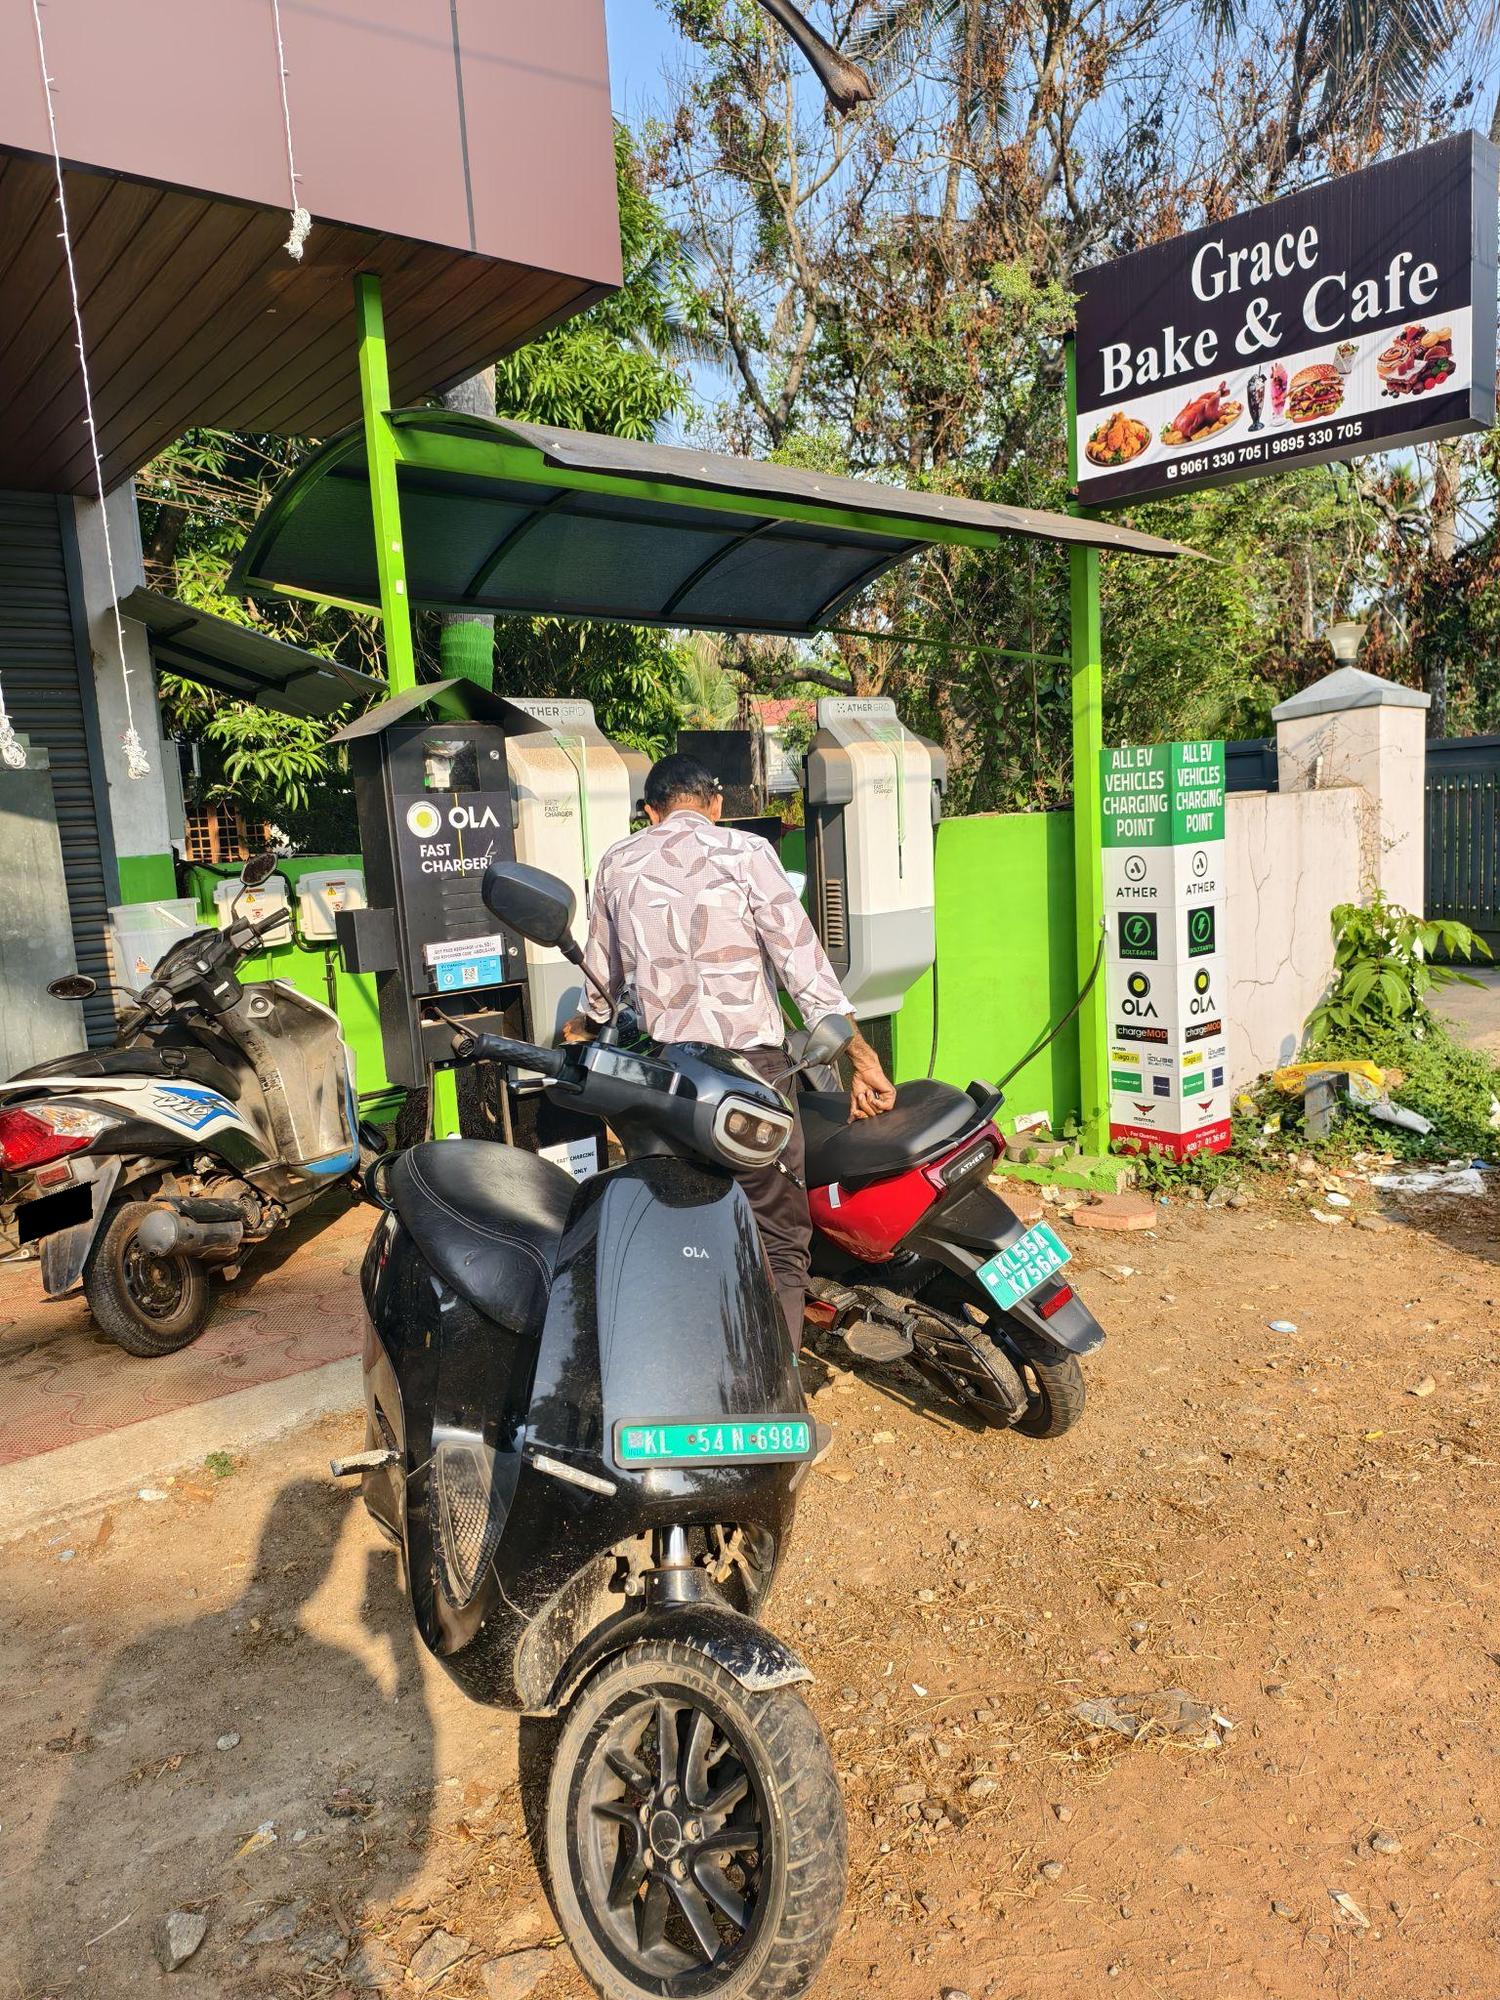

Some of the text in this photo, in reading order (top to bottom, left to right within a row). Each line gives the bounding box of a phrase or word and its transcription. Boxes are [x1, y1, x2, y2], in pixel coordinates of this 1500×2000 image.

[1191, 225, 1318, 301] Grace
[1099, 251, 1438, 397] Bake & Cafe
[1180, 458, 1208, 475] 9061
[1212, 452, 1235, 469] 330
[1238, 445, 1262, 462] 705
[1272, 435, 1304, 454] 9895
[1308, 428, 1333, 446] 330
[1337, 421, 1362, 440] 705
[1112, 748, 1153, 769] ALL EV
[1183, 743, 1212, 763] ALL EV
[1105, 770, 1164, 792] VEHICLES
[1177, 765, 1220, 787] VEHICLES
[1103, 794, 1168, 815] CHARGING
[1176, 789, 1223, 811] CHARGING
[449, 805, 500, 829] OLA
[1116, 818, 1155, 837] POINT
[1186, 813, 1214, 833] POINT
[420, 844, 451, 858] FAST
[421, 857, 488, 873] CHARGER
[1116, 887, 1157, 898] ATHER
[1186, 881, 1215, 896] ATHER
[1122, 999, 1158, 1018] OLA
[1190, 996, 1216, 1015] OLA
[960, 1152, 985, 1174] ATHER
[683, 1246, 709, 1259] OLA
[1008, 1247, 1062, 1296] K7564
[644, 1426, 806, 1455] KL 54 N 6984
